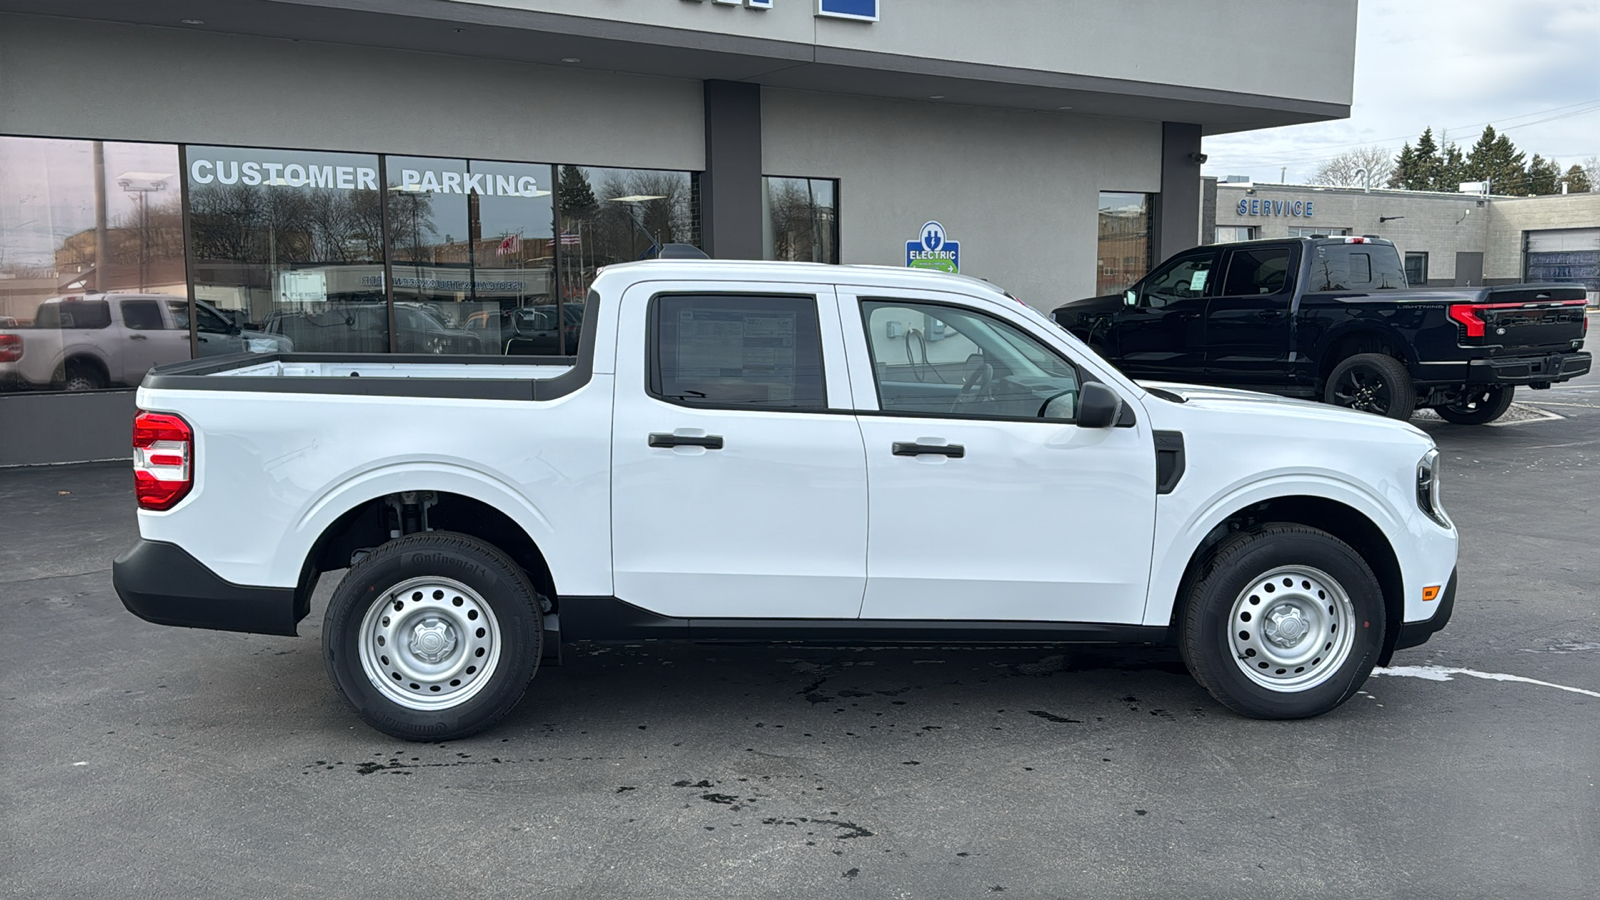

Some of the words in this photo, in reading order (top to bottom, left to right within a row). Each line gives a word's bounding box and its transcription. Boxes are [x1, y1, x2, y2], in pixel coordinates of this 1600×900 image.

[191, 159, 378, 191] CUSTOMER
[401, 169, 537, 198] PARKING
[1238, 198, 1314, 217] SERVICE
[909, 250, 956, 260] ELECTRIC
[411, 552, 479, 573] Continental
